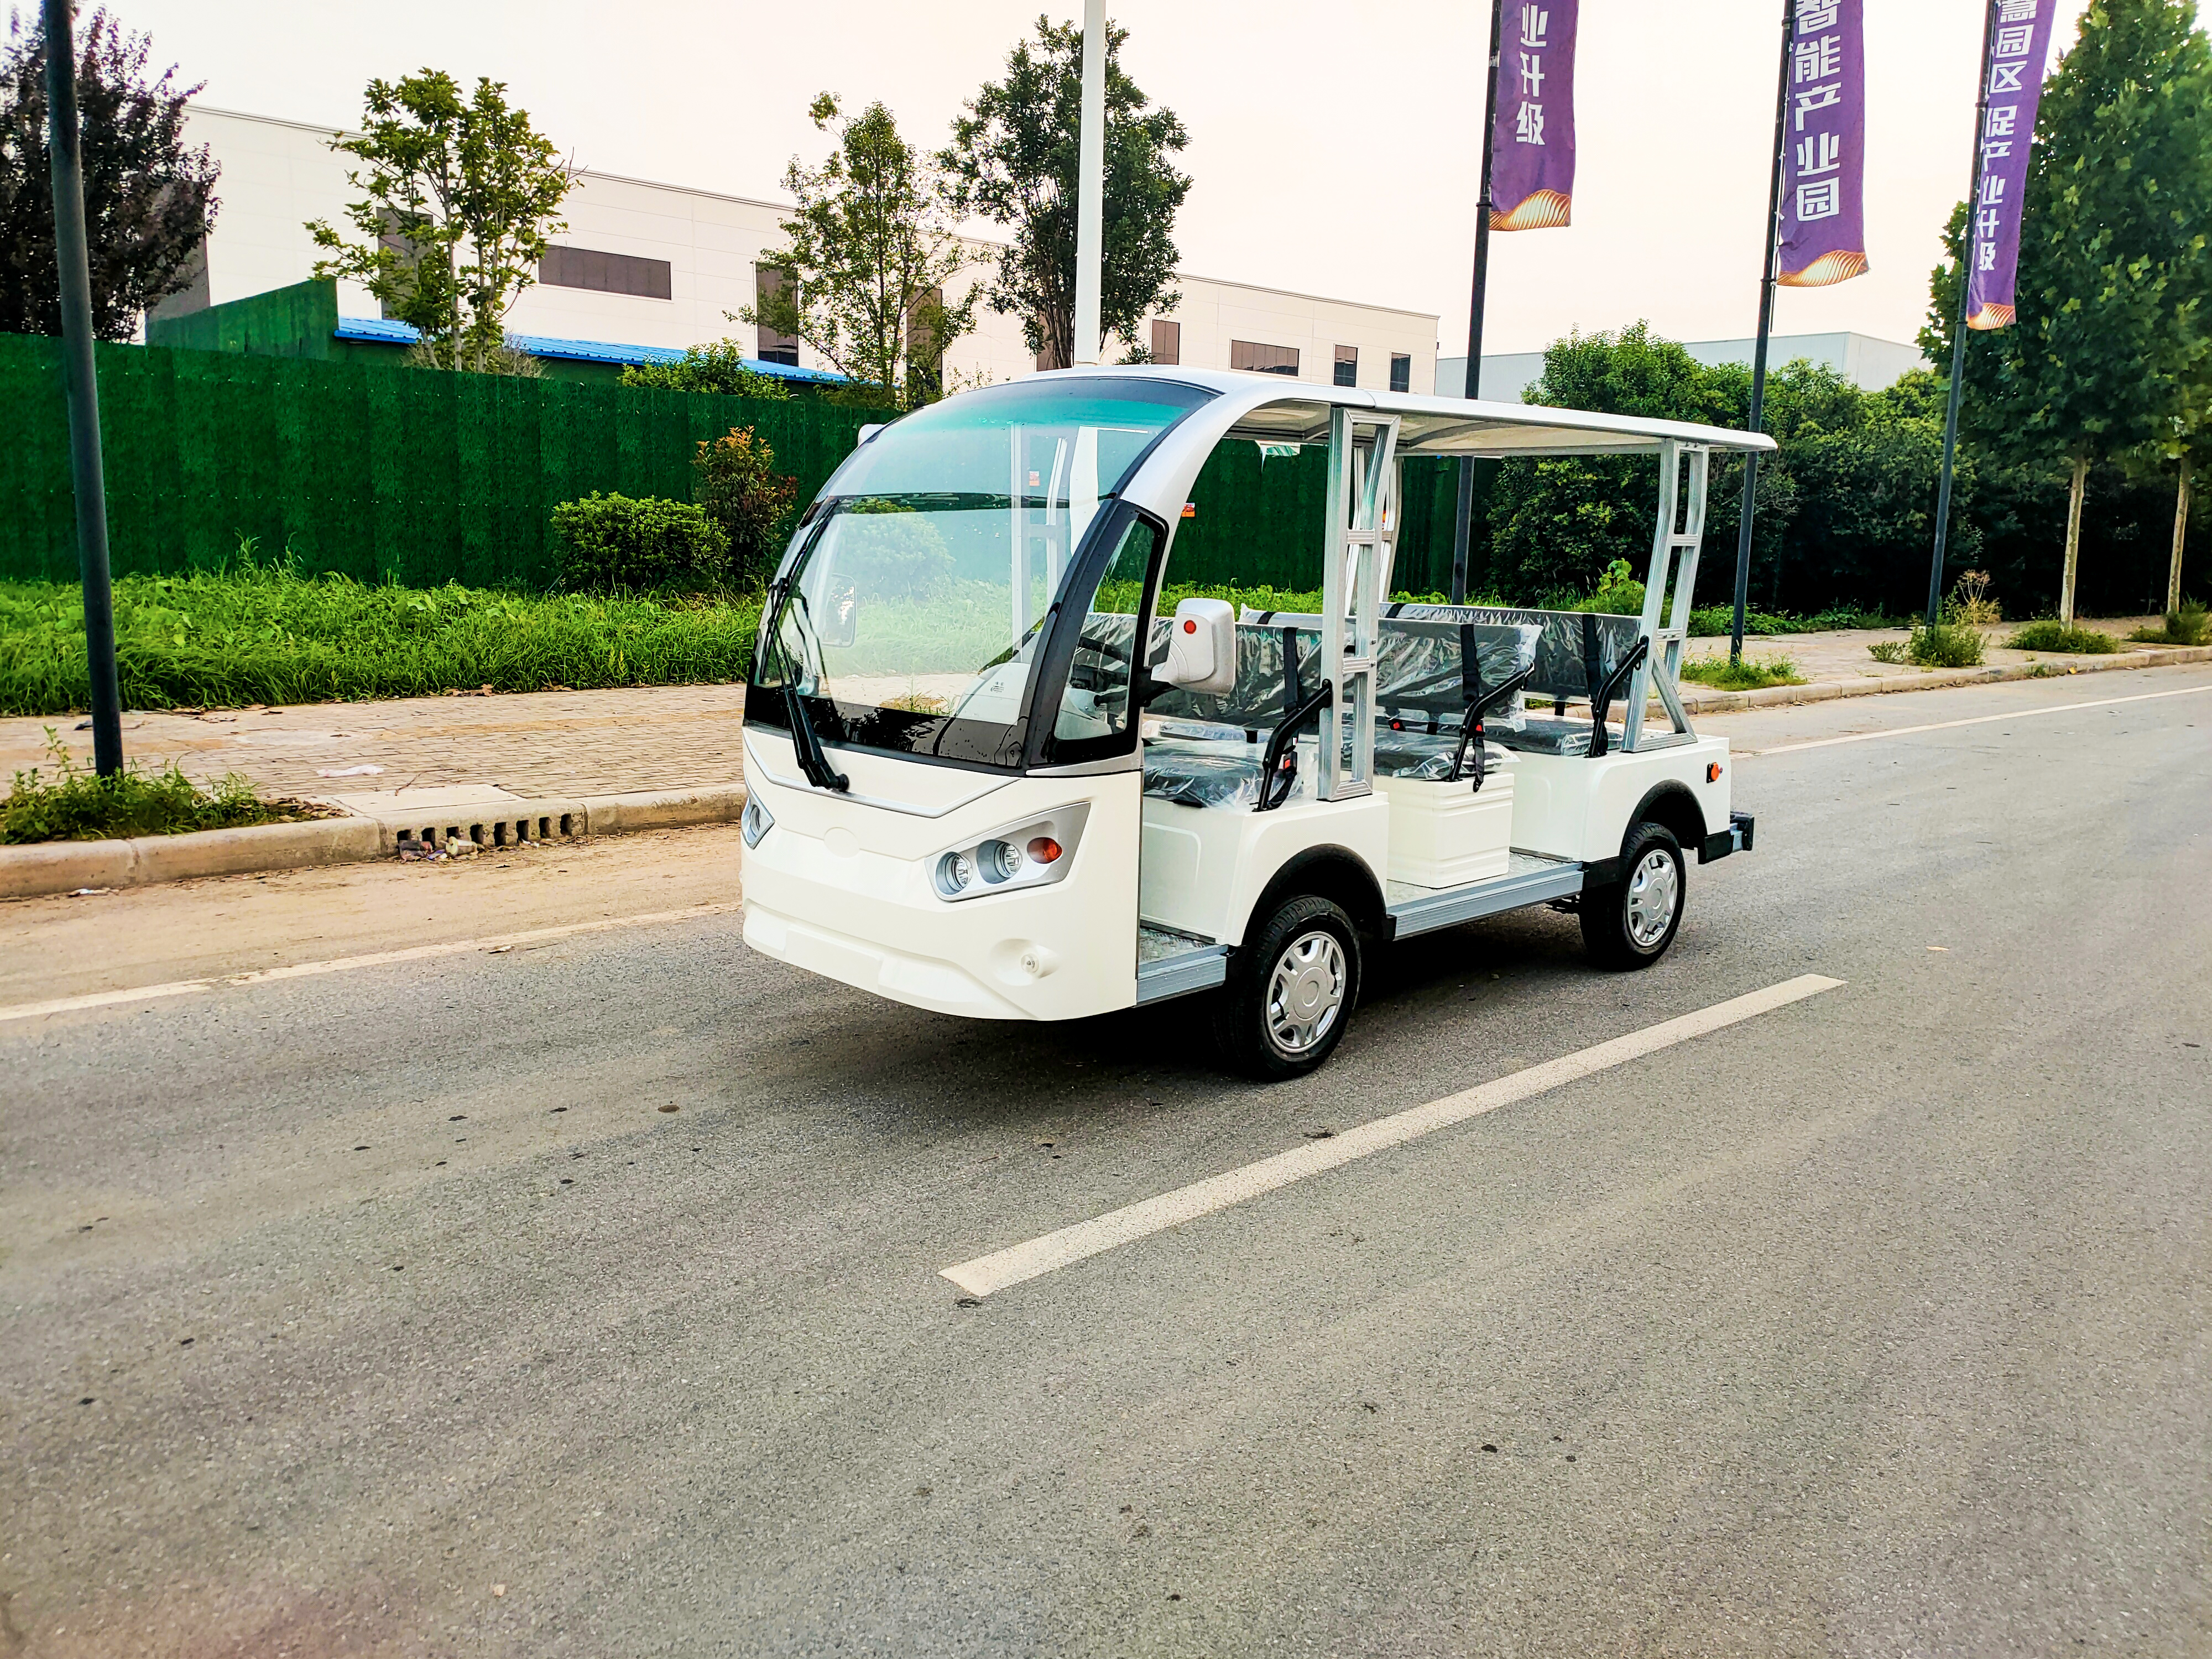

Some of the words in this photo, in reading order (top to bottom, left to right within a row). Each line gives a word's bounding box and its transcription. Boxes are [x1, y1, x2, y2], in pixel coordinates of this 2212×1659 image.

[1516, 2, 1548, 145] 业升级
[1795, 0, 1841, 221] 智能产业园
